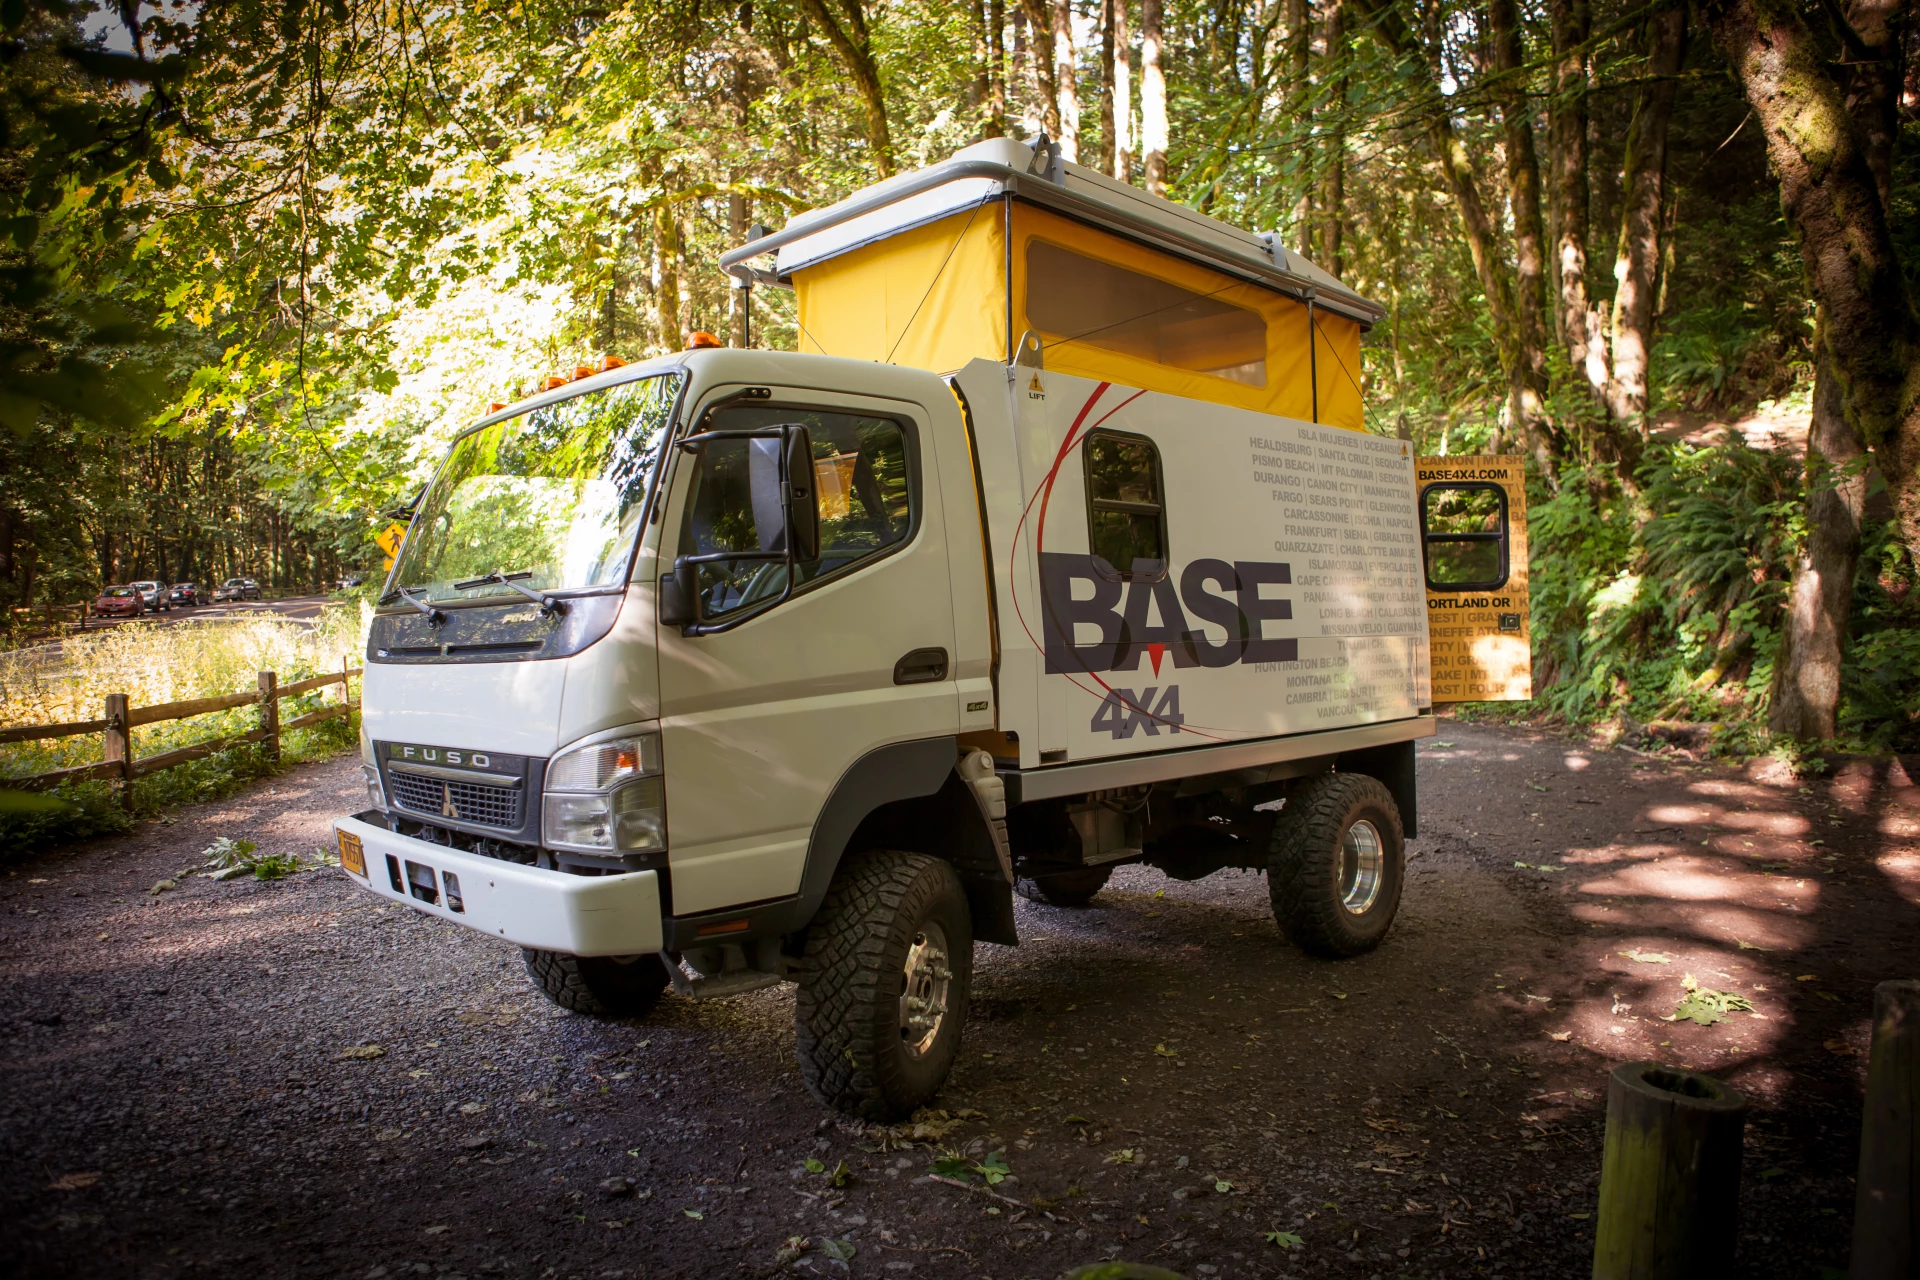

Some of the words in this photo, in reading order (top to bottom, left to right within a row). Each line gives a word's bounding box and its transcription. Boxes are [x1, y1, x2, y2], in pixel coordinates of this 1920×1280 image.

[1029, 392, 1045, 401] LIFT
[1298, 428, 1318, 442] ISLA
[1319, 432, 1359, 449] MUJERES
[1364, 440, 1403, 456] OCEANSID
[1250, 436, 1312, 456] HEALDSBURG
[1318, 447, 1347, 462] SANTA
[1347, 452, 1371, 466] CRUZ
[1374, 456, 1408, 471] SEQUOIA
[1420, 456, 1474, 466] CANYON
[1483, 456, 1500, 465] MT
[1505, 455, 1524, 465] SH
[1252, 454, 1283, 469] PISMO
[1284, 458, 1315, 473] BEACH
[1321, 464, 1334, 476] MT
[1335, 467, 1374, 482] PALOMAR
[1379, 472, 1409, 486] SEDONA
[1418, 469, 1508, 481] BASE4X4.COM
[1253, 471, 1301, 487] DURANGO
[1307, 477, 1338, 492] CANON
[1339, 482, 1358, 495] CITY
[1364, 485, 1411, 501] MANHATTAN
[1272, 490, 1303, 504] FARGO
[1309, 494, 1338, 507] SEARS
[1339, 497, 1364, 510] POINT
[1369, 501, 1412, 515] GLENWOOD
[1284, 508, 1349, 524] CARCASSONNE
[1354, 514, 1381, 527] ISCHIA
[1386, 518, 1413, 529] NAPOLI
[1284, 525, 1338, 539] FRANKFURT
[1343, 529, 1369, 541] SIENA
[1373, 531, 1415, 544] GIBRALTER
[1274, 540, 1335, 555] QUARZAZATE
[1340, 544, 1388, 557] CHARLOTTE
[1389, 548, 1416, 559] AMALIE
[1309, 558, 1364, 572] ISLAMORADA
[1369, 562, 1417, 573] EVERGLADES
[1297, 575, 1321, 587] CAPE
[1322, 575, 1373, 588] CANAVERAL
[1377, 576, 1403, 588] CEDAR
[1404, 577, 1418, 588] KEY
[1303, 591, 1340, 603] PANAMA
[1367, 592, 1385, 603] NEW
[1386, 592, 1420, 603] ORLEANS
[1427, 598, 1489, 609] ORTLAND
[1492, 597, 1510, 608] OR
[1038, 552, 1298, 674] BASE
[1319, 608, 1344, 619] LONG
[1345, 607, 1373, 619] BEACH
[1378, 607, 1422, 618] CALABASAS
[1321, 623, 1357, 636] MISSION
[1358, 622, 1383, 634] VEIJO
[1388, 621, 1423, 633] GUAYMAS
[1337, 638, 1367, 651] TULUM
[1407, 635, 1424, 648] ITZA
[1255, 659, 1319, 674] HUNTINGTON
[1320, 656, 1349, 669] BEACH
[1355, 653, 1392, 666] TOPANGA
[1287, 675, 1332, 689] MONTANA
[1333, 673, 1346, 684] DE
[1370, 667, 1404, 681] BISHOPS
[1286, 692, 1328, 706] CAMBRIA
[1333, 689, 1349, 701] BIG
[1351, 686, 1368, 699] SUR
[1372, 683, 1405, 697] LAGUNA
[1091, 684, 1184, 740] 4X4
[1317, 701, 1369, 719] VANCOUVER
[403, 746, 490, 768] FUSO
